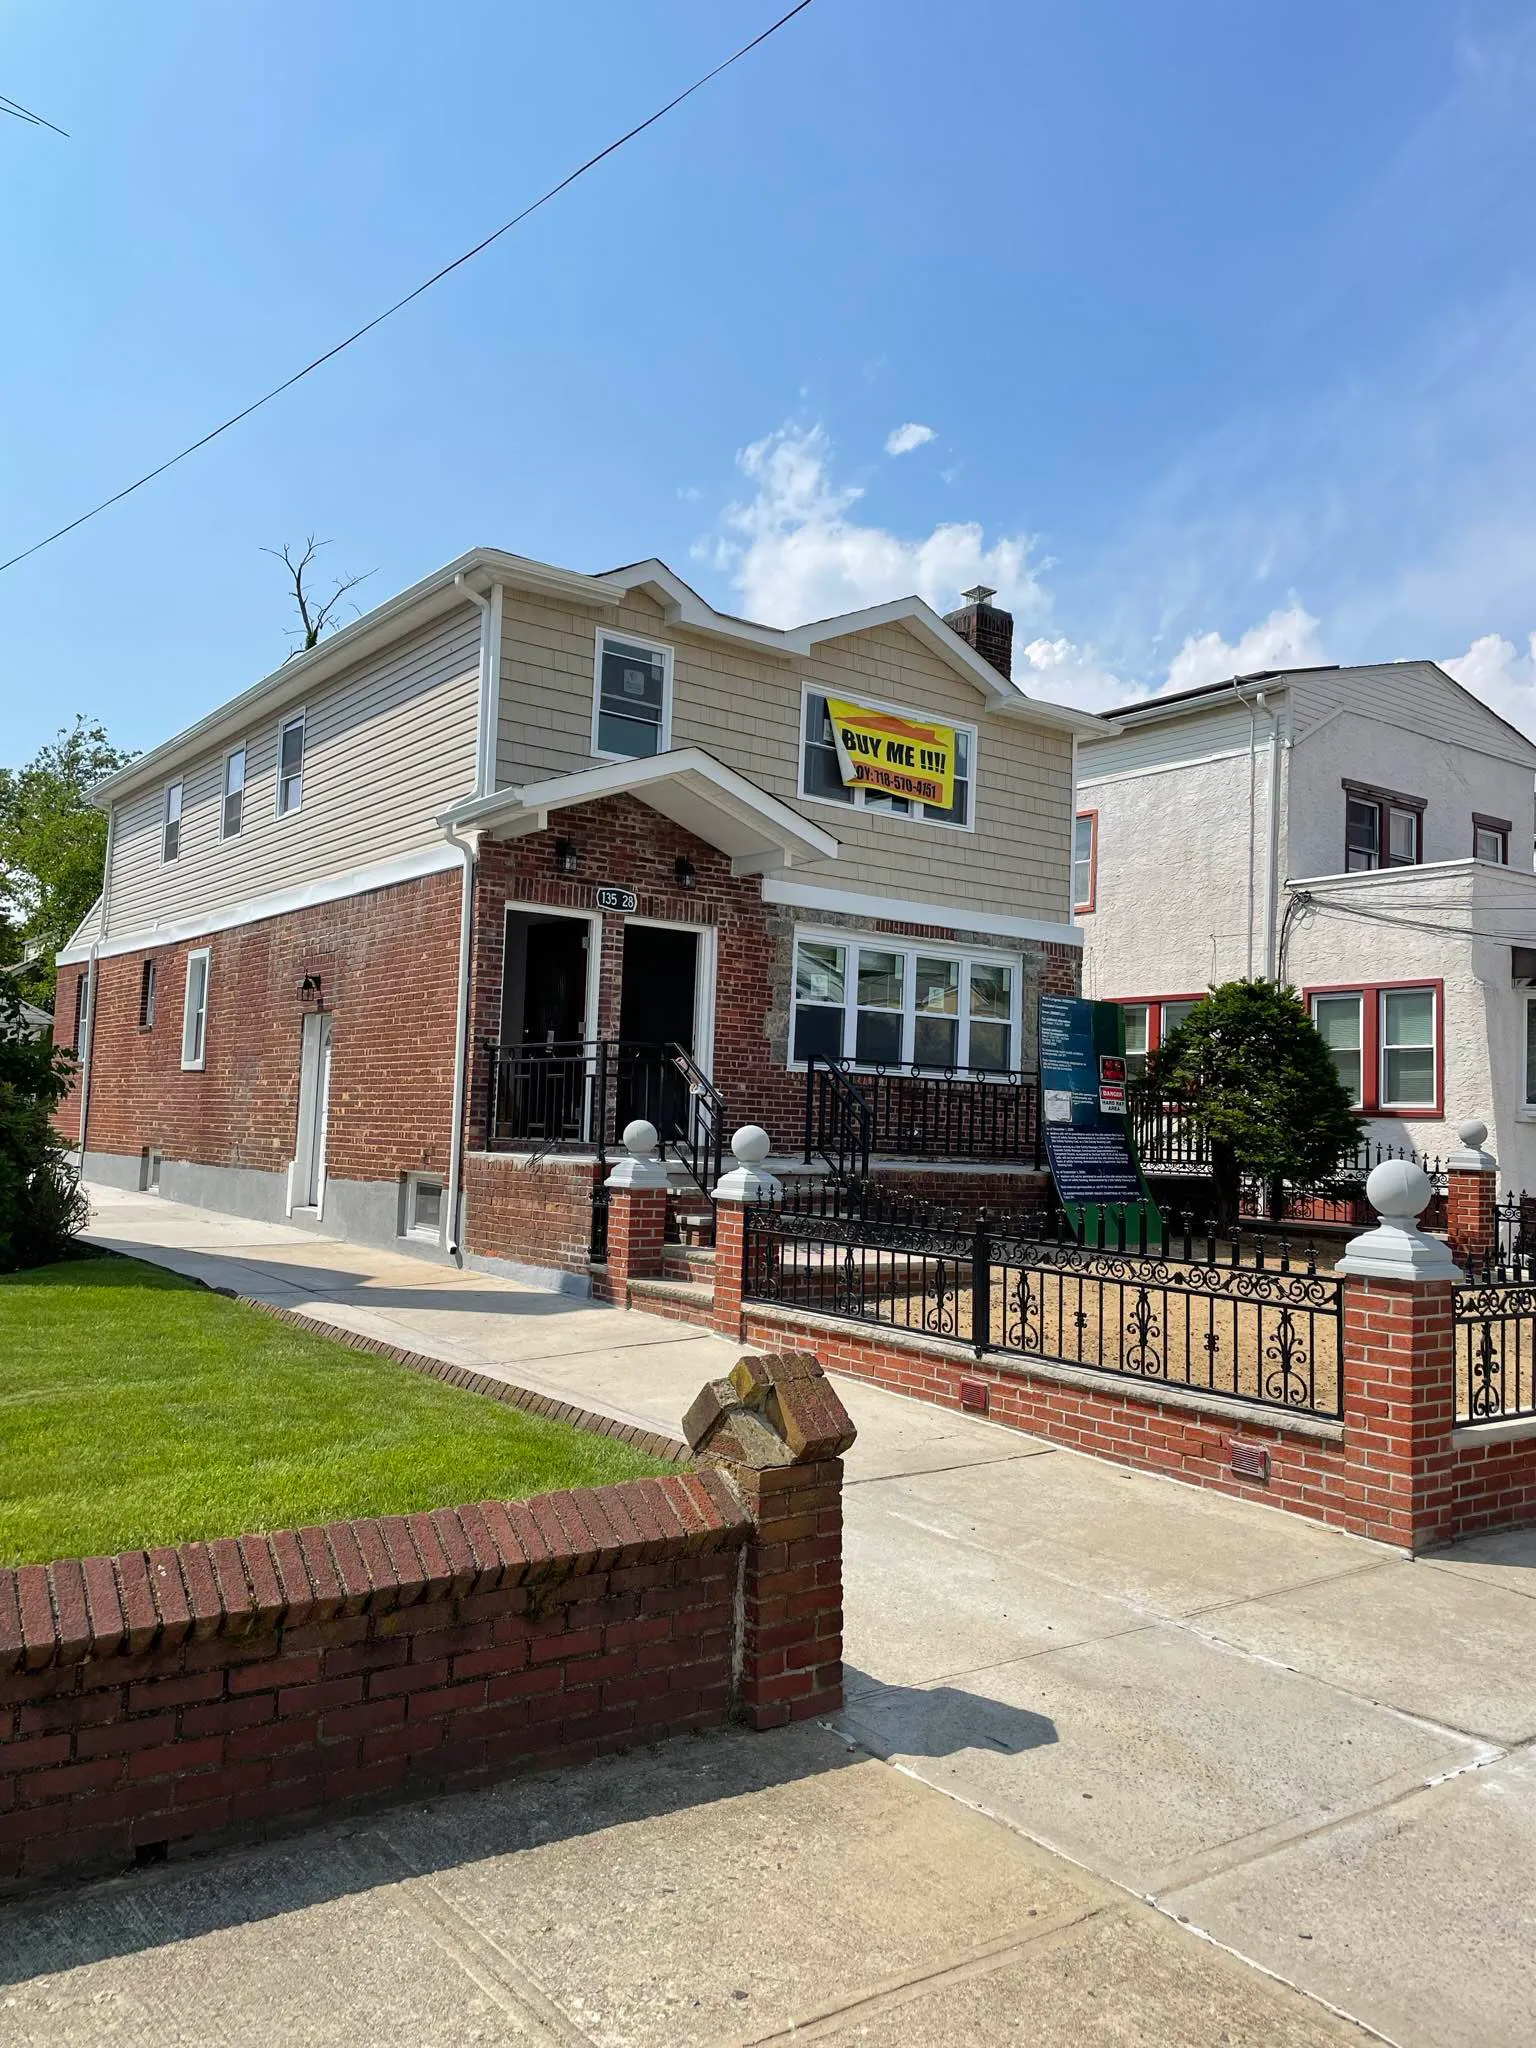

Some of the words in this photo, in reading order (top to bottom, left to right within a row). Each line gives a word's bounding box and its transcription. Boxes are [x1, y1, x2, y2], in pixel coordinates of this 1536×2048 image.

[842, 728, 882, 759] BUY
[886, 741, 915, 768] ME
[601, 891, 618, 906] 135
[622, 894, 634, 908] 28
[1102, 1090, 1123, 1098] DANGER
